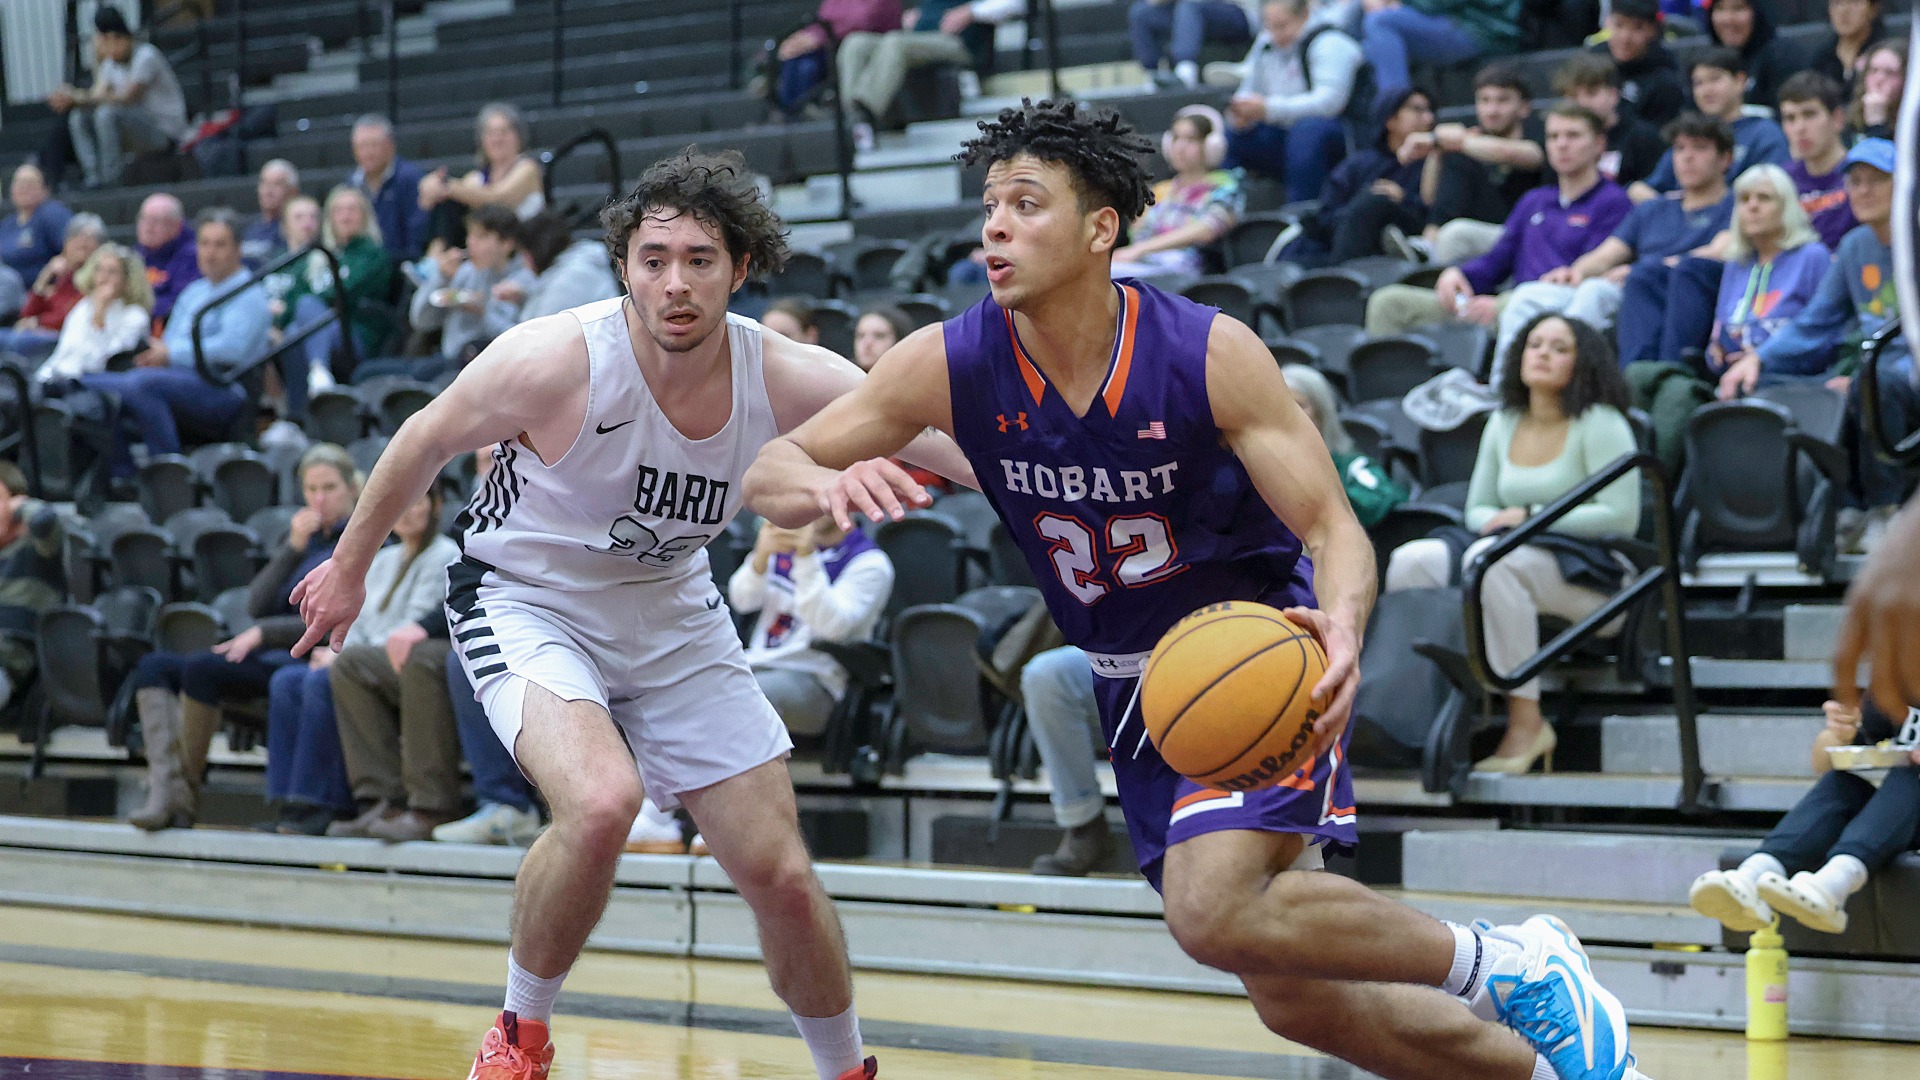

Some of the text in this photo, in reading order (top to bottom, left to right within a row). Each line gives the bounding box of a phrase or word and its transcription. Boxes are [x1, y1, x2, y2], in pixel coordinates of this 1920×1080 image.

[633, 464, 730, 525] BARD
[1000, 459, 1179, 503] HOBART
[1032, 510, 1191, 607] 22
[1214, 708, 1320, 792] Wilson
